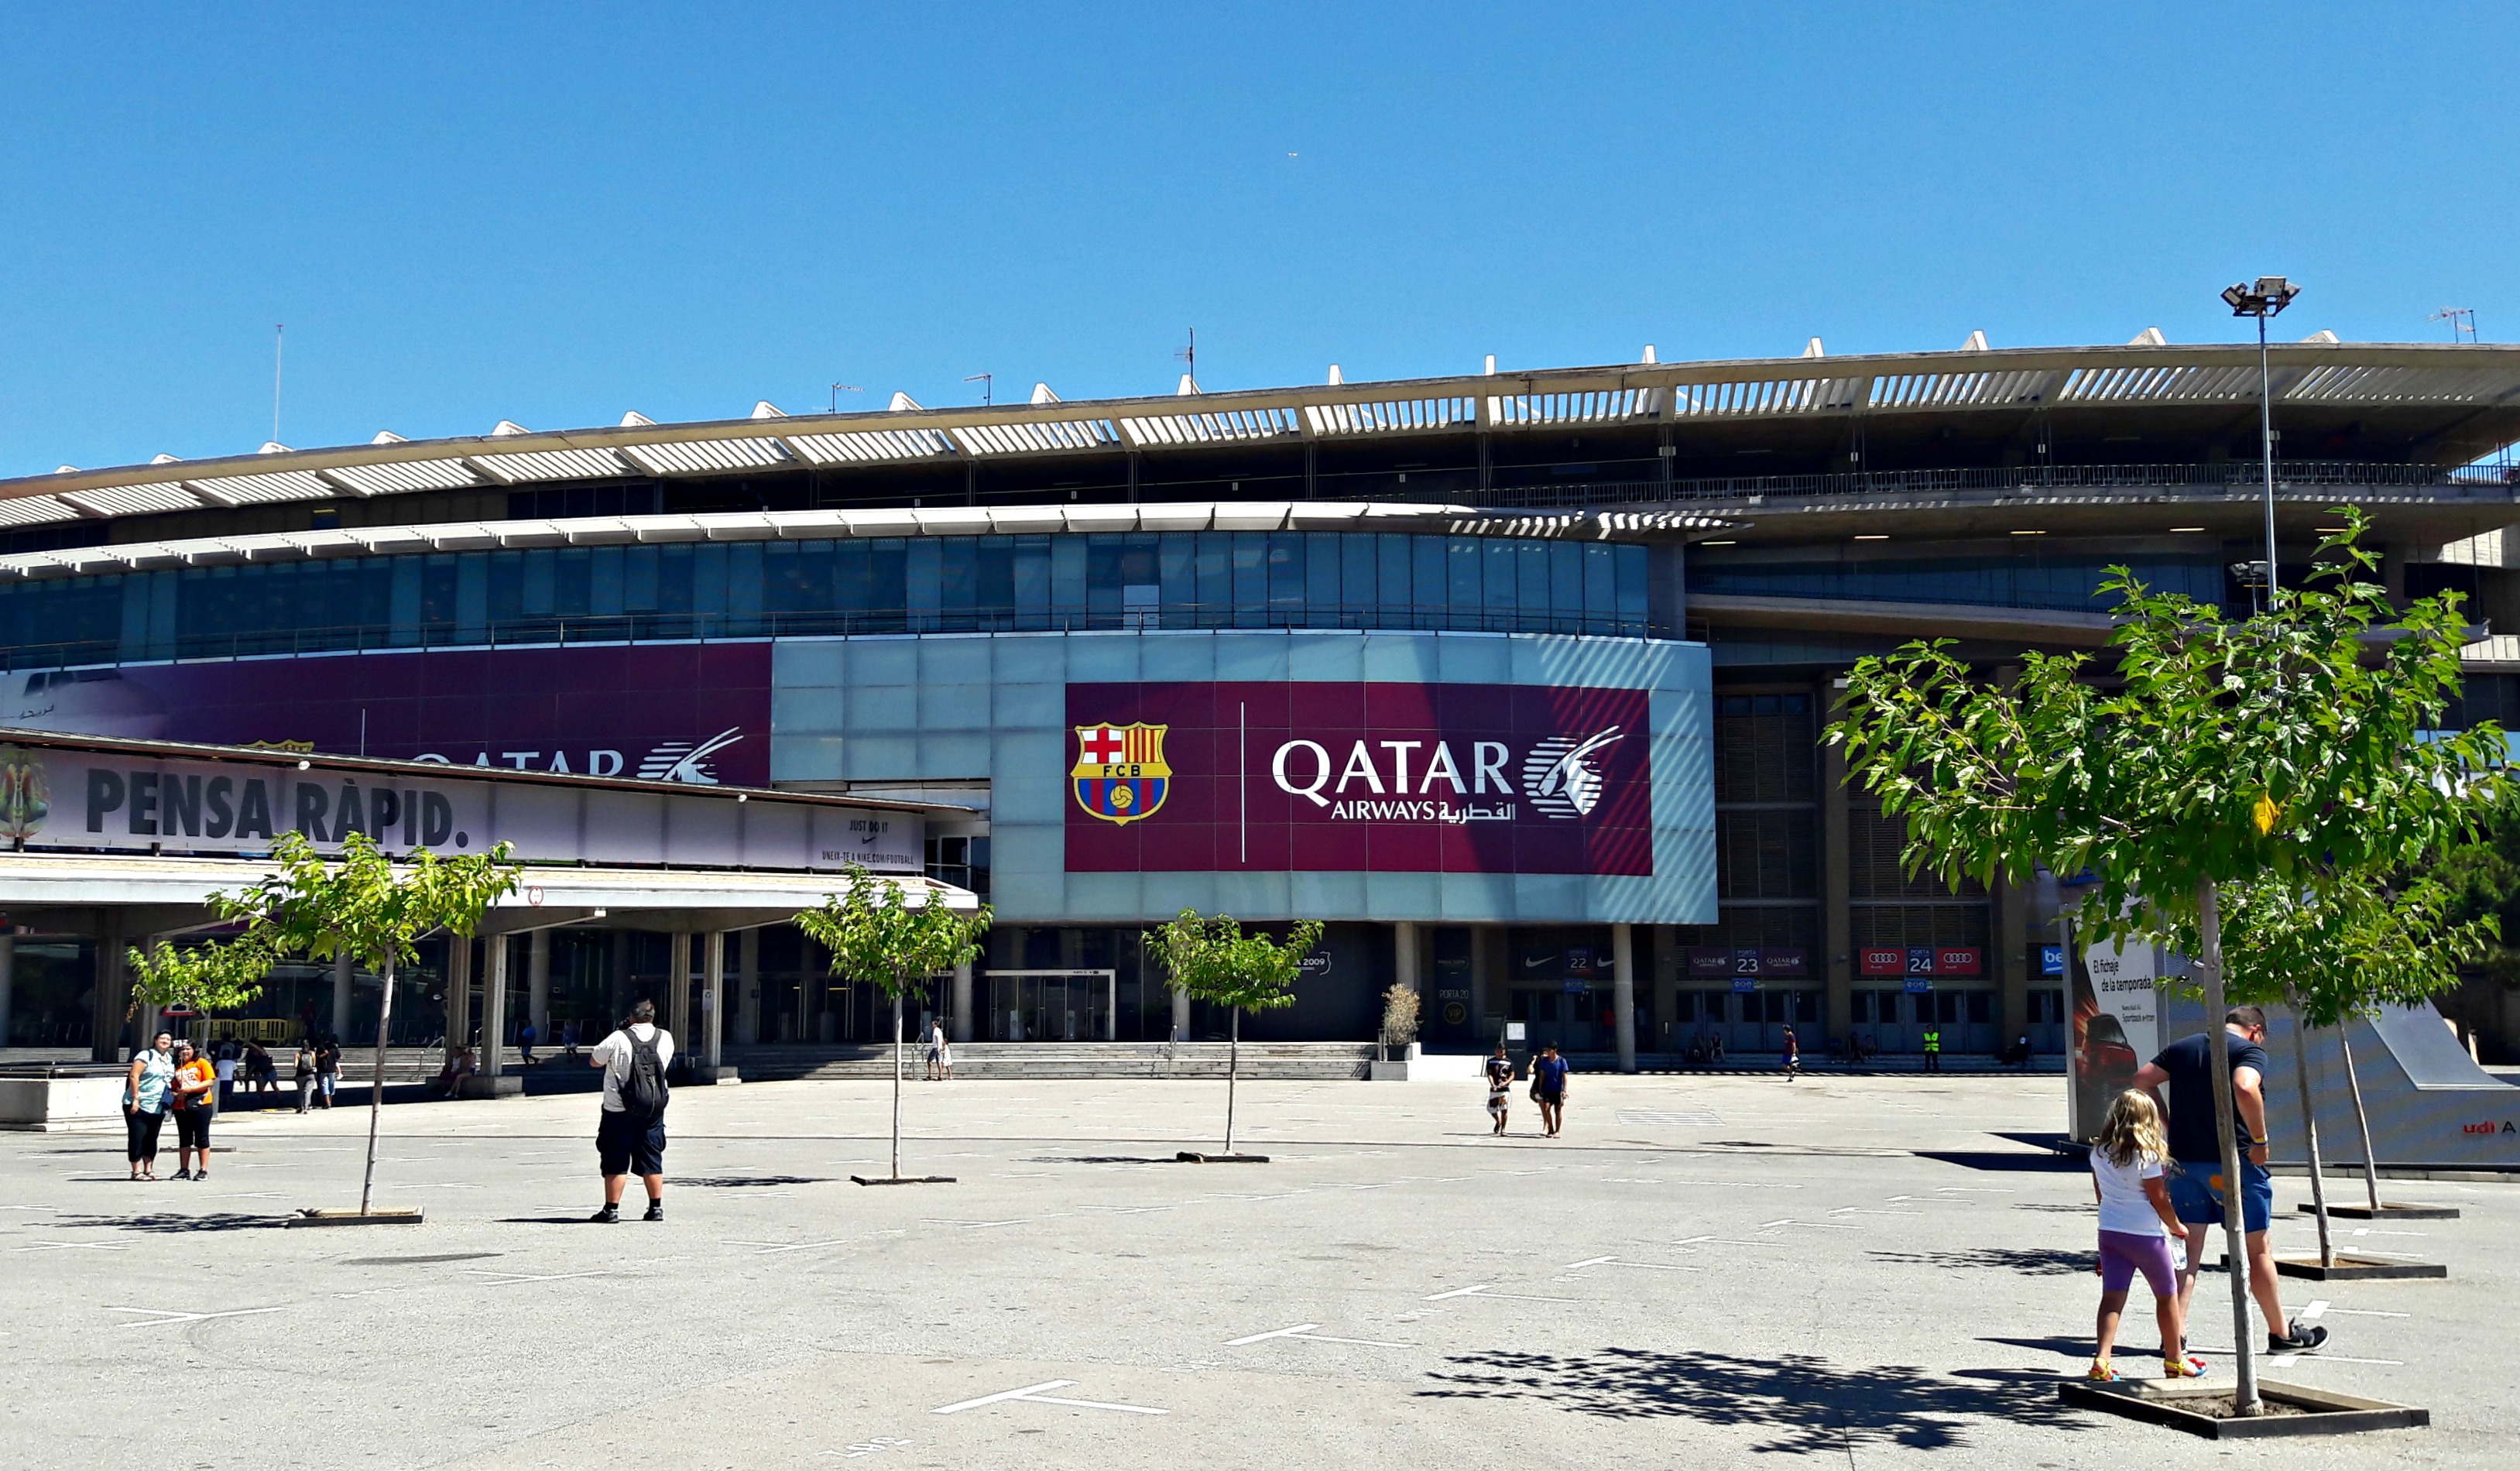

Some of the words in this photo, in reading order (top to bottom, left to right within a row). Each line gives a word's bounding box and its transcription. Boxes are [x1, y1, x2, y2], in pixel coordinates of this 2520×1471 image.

[1272, 739, 1515, 806] QATAR
[87, 768, 272, 839] PENSA
[297, 777, 469, 849] RÀPID.
[1331, 801, 1435, 820] AIRWAYS
[1438, 801, 1516, 825] القطرية
[849, 819, 866, 832] JUST
[869, 821, 879, 833] DO
[882, 822, 889, 834] IT
[822, 850, 850, 862] UNEIX-TE
[852, 852, 856, 862] A
[857, 853, 914, 865] NIKE.COM/FOOTBALL
[1302, 958, 1326, 967] 2009
[1570, 957, 1586, 969] 22
[1737, 958, 1759, 973] 23
[1909, 957, 1932, 973] 24
[2093, 959, 2100, 973] El
[2100, 958, 2119, 976] fichaje
[2101, 978, 2109, 992] de
[2110, 978, 2116, 991] la
[1439, 989, 1459, 999] PORTA
[1460, 989, 1469, 999] 20
[1448, 1008, 1462, 1018] VIP
